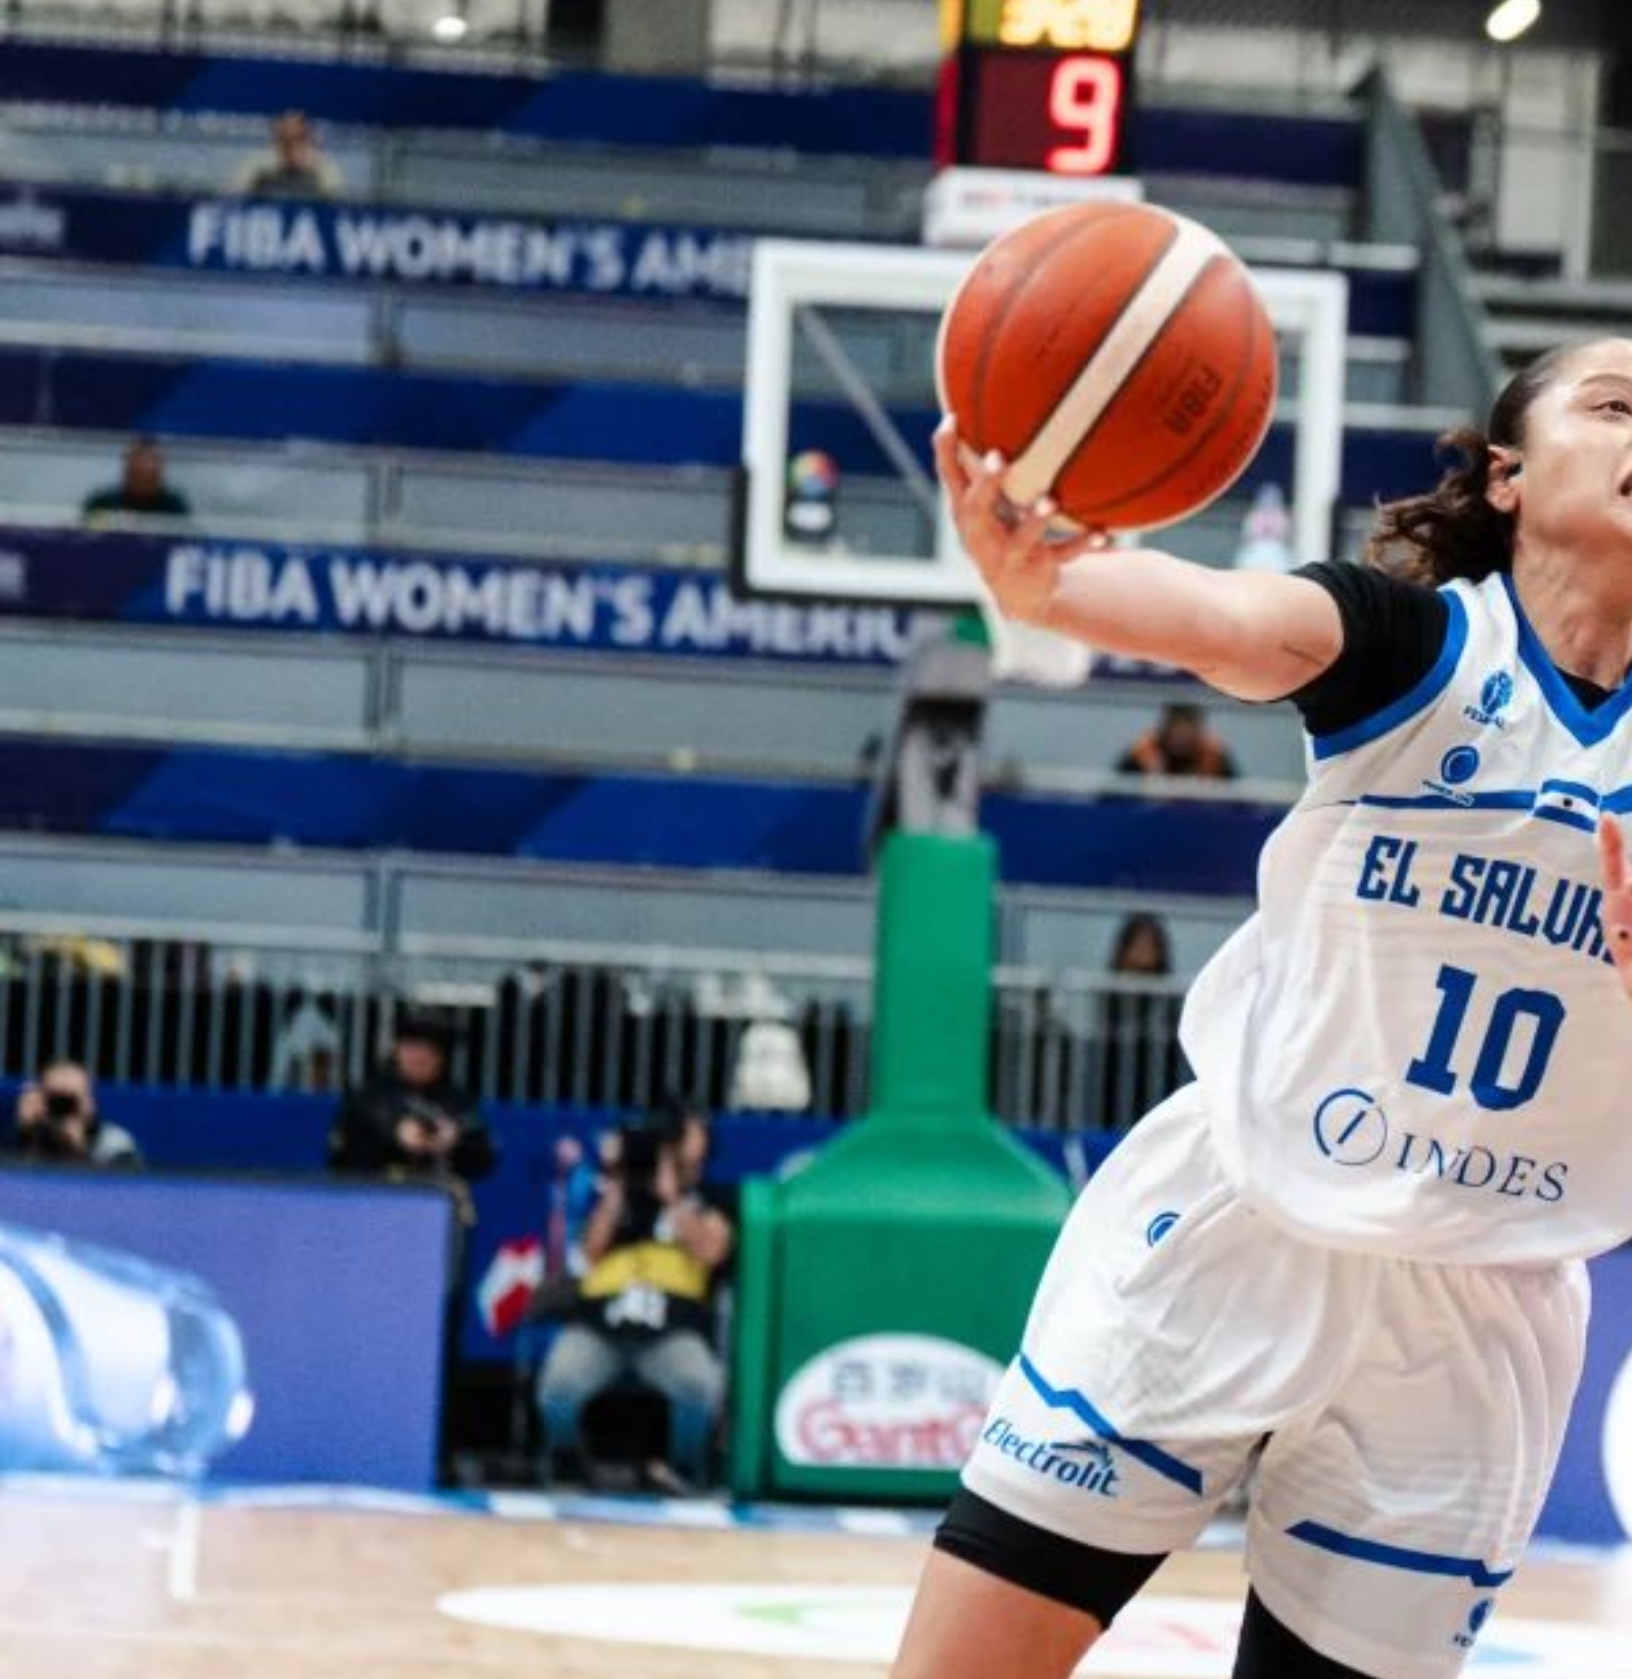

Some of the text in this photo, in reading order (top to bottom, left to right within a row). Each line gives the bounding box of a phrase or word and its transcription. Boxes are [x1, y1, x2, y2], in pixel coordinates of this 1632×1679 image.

[1047, 54, 1119, 176] 9
[187, 203, 327, 272] FIBA
[335, 210, 624, 291] WOMEN'S
[165, 546, 319, 623] FIBA
[329, 556, 654, 647] WOMEN'S
[1356, 834, 1420, 909] EL
[1404, 963, 1567, 1112] 10
[1394, 1132, 1569, 1202] INDES
[983, 1417, 1121, 1498] Electrolit
